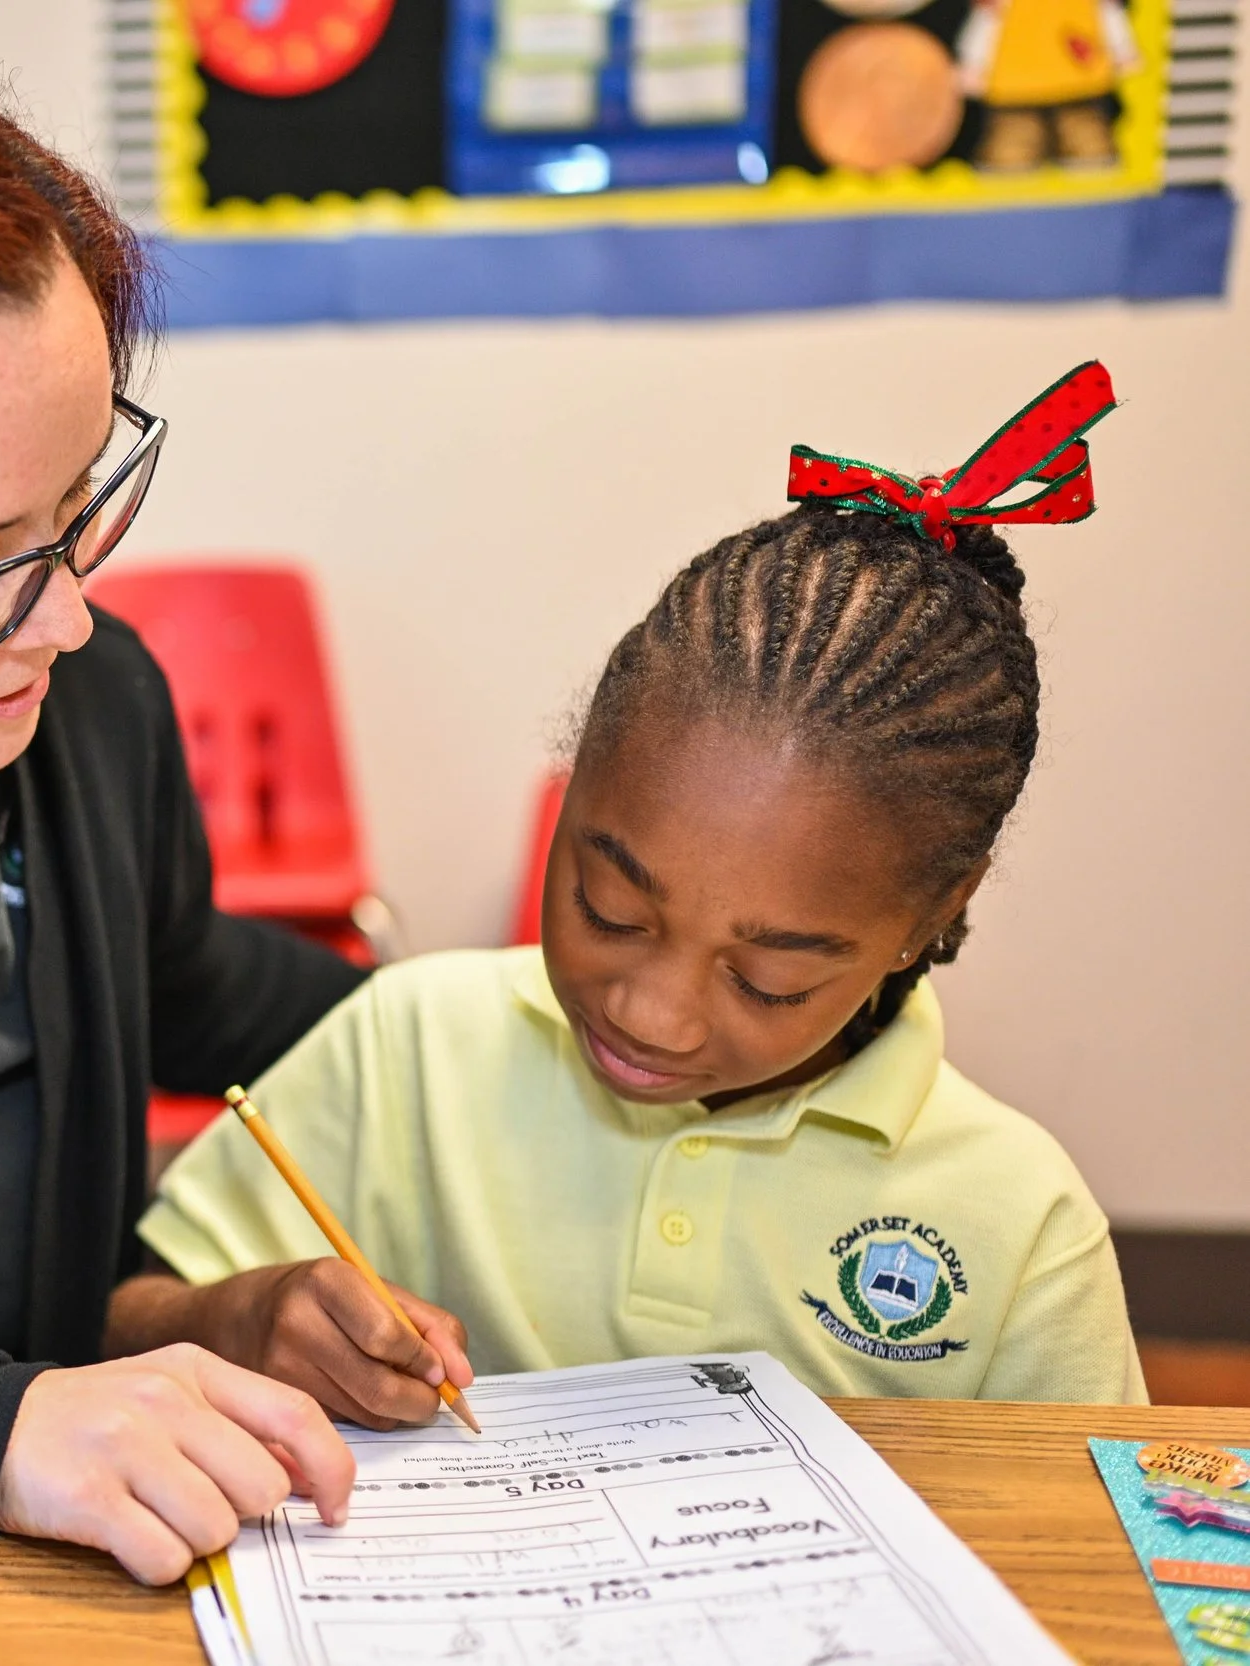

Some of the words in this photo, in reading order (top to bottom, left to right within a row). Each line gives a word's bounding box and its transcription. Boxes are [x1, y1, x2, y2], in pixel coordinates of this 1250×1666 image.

[829, 1216, 911, 1258] SOMERSET
[911, 1223, 968, 1296] ACADEMY
[817, 1310, 875, 1354] EXCELLENCE
[875, 1343, 887, 1357] IN
[889, 1343, 942, 1359] EDUCATION
[576, 1443, 603, 1451] about
[606, 1439, 636, 1447] Write
[439, 1463, 515, 1473] Connection
[520, 1451, 606, 1470] Text-to-Self
[504, 1485, 521, 1498] 5
[531, 1478, 585, 1495] Day
[677, 1498, 771, 1518] Focus
[650, 1519, 840, 1550] Vocabulary
[562, 1596, 582, 1608] 4
[593, 1588, 651, 1602] Day
